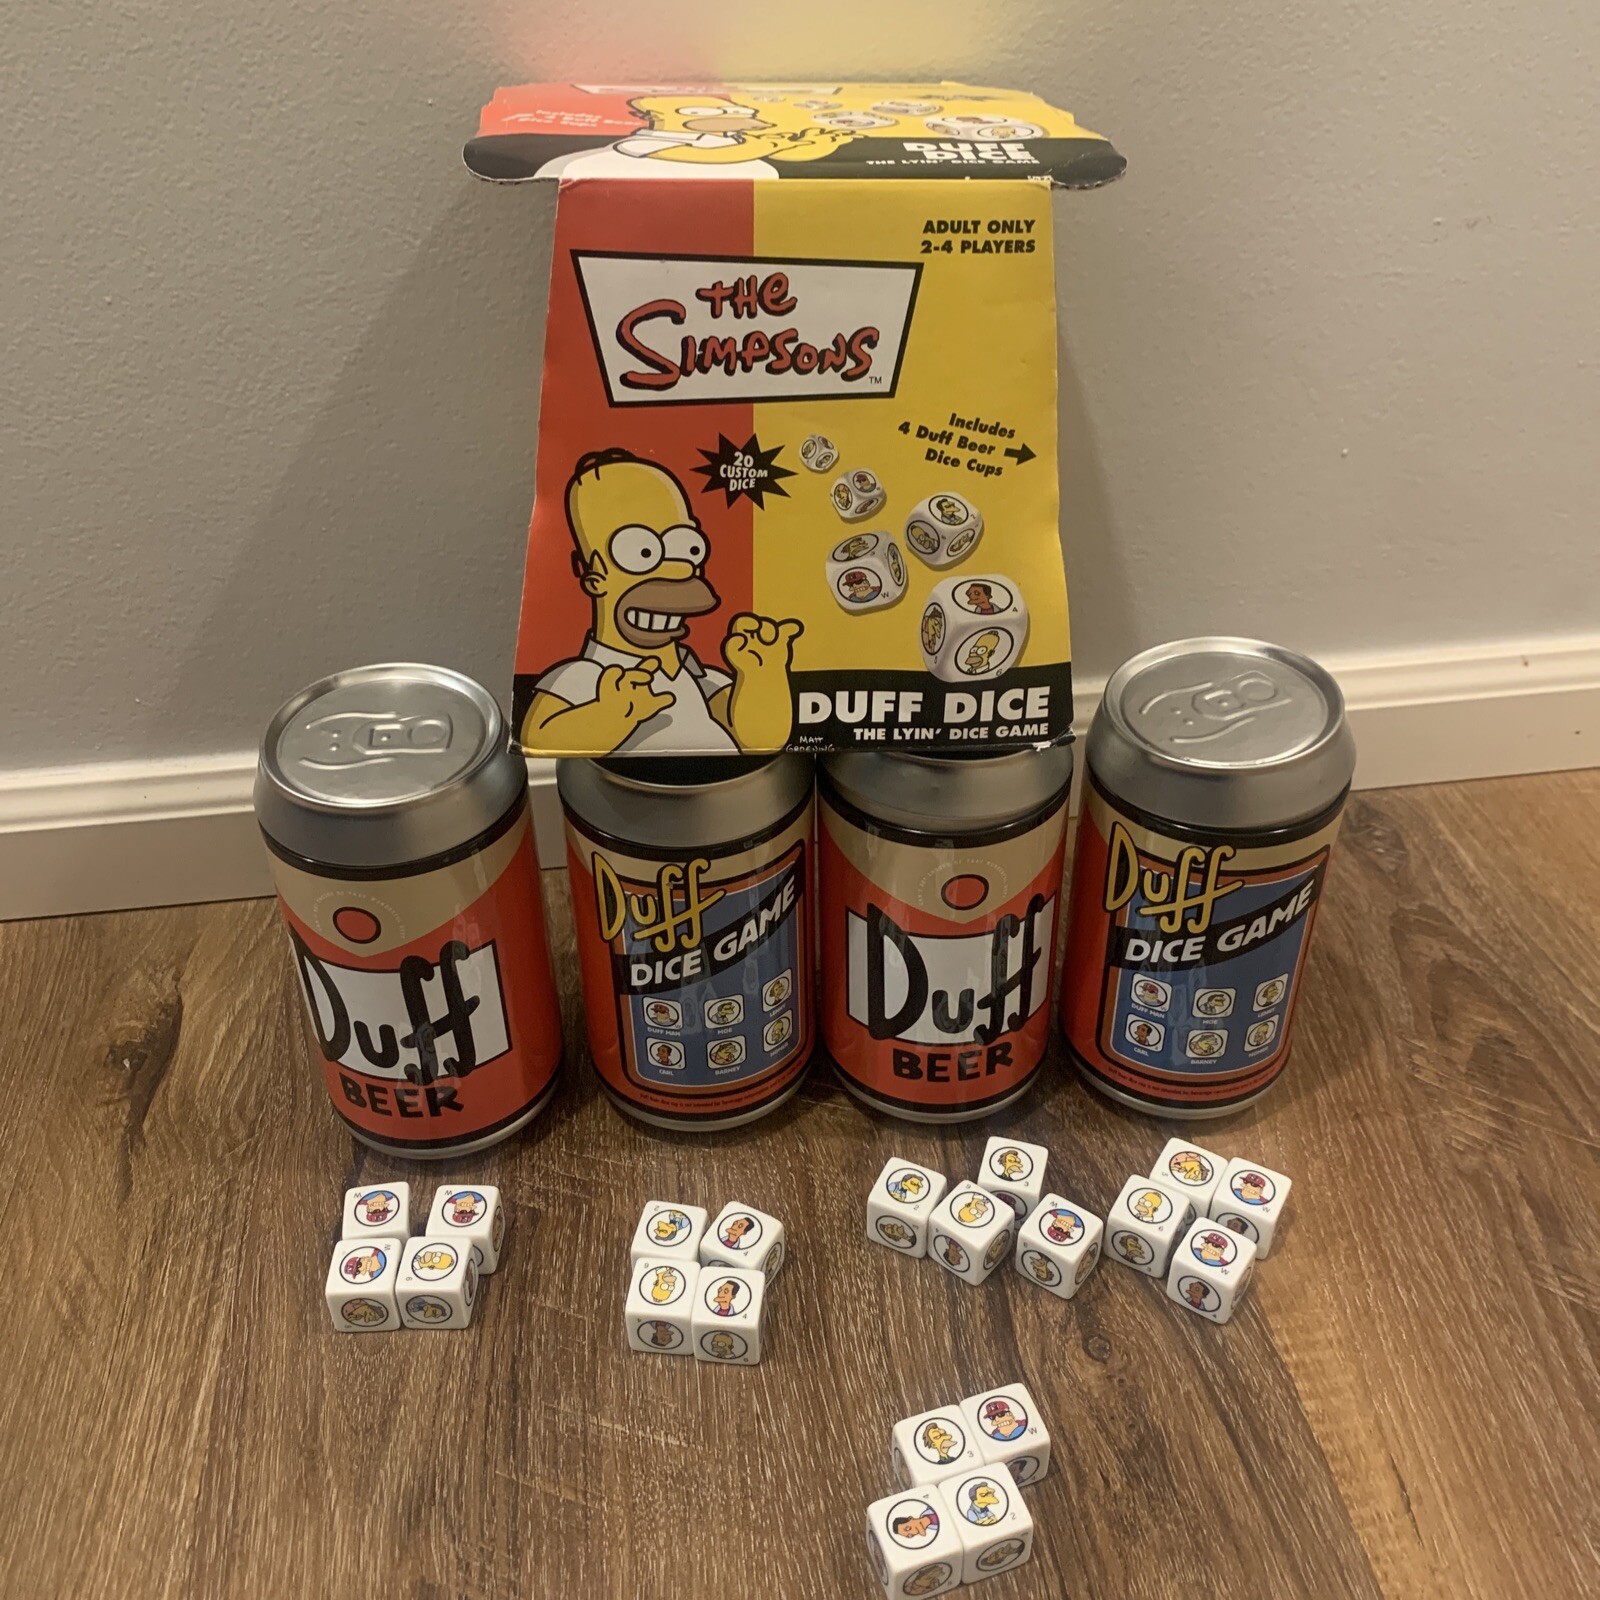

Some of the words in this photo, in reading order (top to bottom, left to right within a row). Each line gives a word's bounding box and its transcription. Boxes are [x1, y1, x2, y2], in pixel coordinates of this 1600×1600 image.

[923, 150, 1035, 160] DICE
[923, 220, 981, 234] ADULT
[987, 220, 1036, 234] ONLY
[920, 240, 953, 254] 2-4
[960, 240, 1036, 254] PLAYERS
[949, 413, 1016, 439] Includes
[898, 421, 910, 435] 4
[916, 425, 954, 446] Duff
[957, 435, 996, 455] Beer
[733, 451, 754, 468] 20
[925, 448, 961, 468] Dice
[966, 459, 1003, 478] Cups
[719, 464, 769, 478] CUSTOM
[729, 478, 756, 492] DICE
[798, 691, 924, 724] DUFF
[943, 686, 1050, 724] DICE
[853, 728, 886, 741] THE
[893, 727, 942, 741] LYIN'
[949, 727, 989, 740] DICE
[995, 723, 1049, 738] GAME
[1103, 821, 1246, 934] Duff
[592, 851, 727, 953] Duff
[1125, 936, 1206, 963] DICE
[1216, 878, 1315, 952] GAME
[631, 949, 702, 987] DICE
[713, 875, 795, 962] GAME
[867, 893, 1045, 1046] Duff
[287, 920, 481, 1086] Duff
[717, 1027, 733, 1035] MOE
[715, 1065, 741, 1076] BARNEY
[892, 1041, 1014, 1083] BEER
[339, 1072, 464, 1118] BEER
[1220, 1267, 1230, 1275] W
[1027, 1427, 1038, 1435] W
[966, 1450, 974, 1458] 3
[1009, 1512, 1017, 1521] 2
